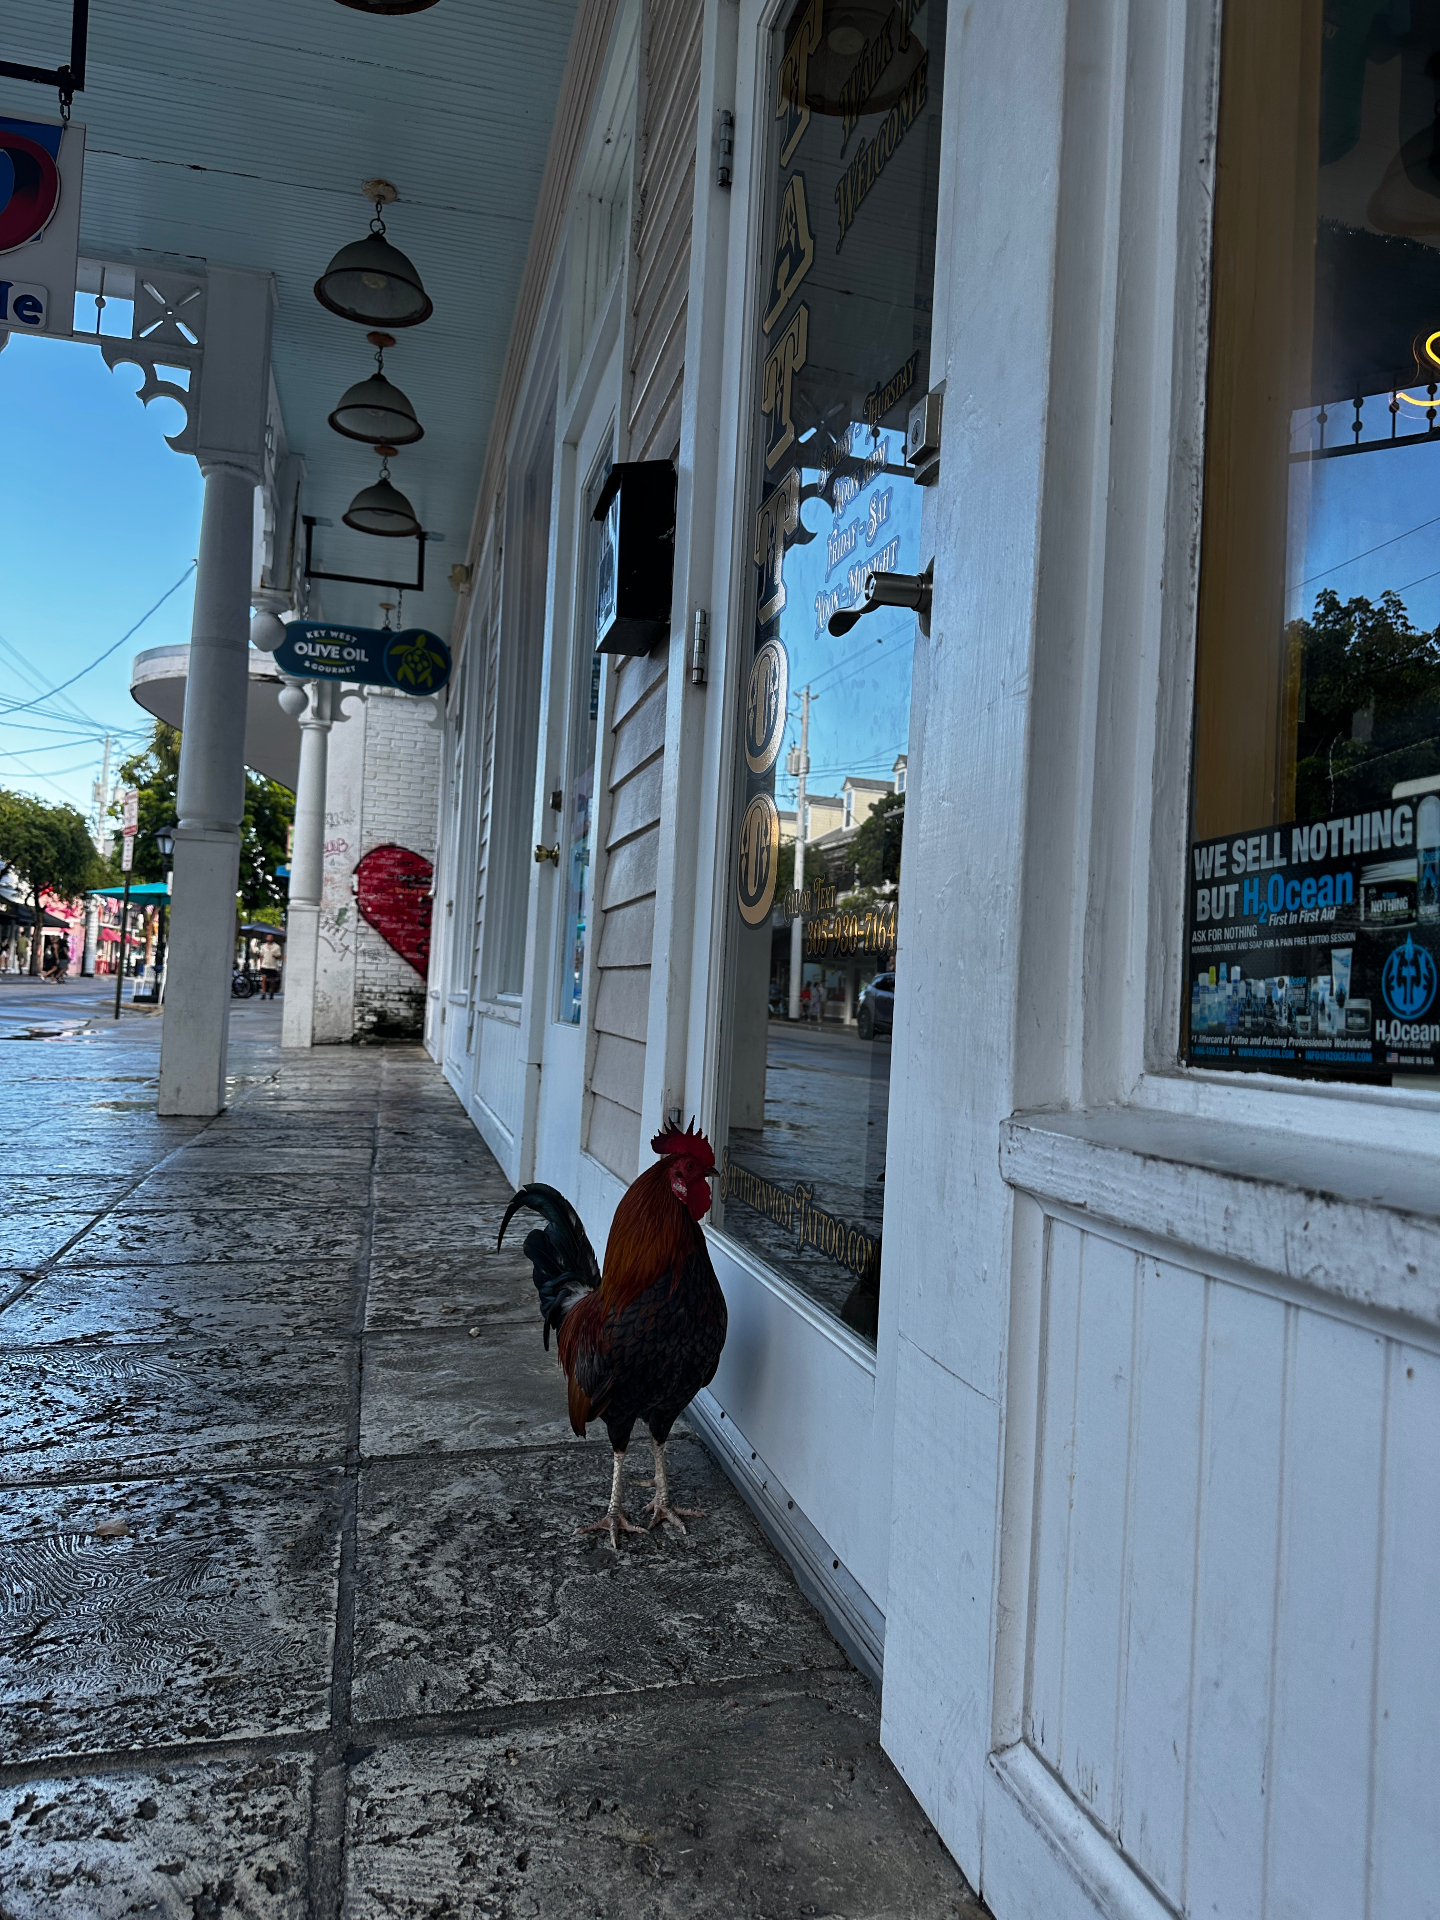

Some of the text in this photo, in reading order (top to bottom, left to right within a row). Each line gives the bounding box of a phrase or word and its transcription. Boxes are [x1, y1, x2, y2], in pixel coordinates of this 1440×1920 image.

[839, 8, 895, 158] WALK
[835, 50, 928, 254] WELCOME
[863, 350, 919, 445] THURSDAY
[825, 517, 859, 582] FRIDAY
[865, 487, 893, 546] SAT
[305, 630, 358, 643] KEY WEST
[294, 641, 369, 662] OLIVE OIL
[311, 662, 356, 674] GOURMET
[1194, 804, 1413, 880] WE SELL NOTHING
[800, 890, 811, 912] OR
[814, 872, 836, 915] TEXT
[1197, 871, 1353, 924] BUT H2Ocean
[1371, 897, 1408, 913] NOTHING
[1269, 907, 1336, 926] First In First Aid
[806, 908, 896, 955] 305-930-7164
[1192, 925, 1258, 943] ASK FOR NOTHING
[1213, 943, 1236, 953] OINTMENT
[1238, 941, 1248, 950] AND
[1249, 940, 1262, 950] SOAP
[1264, 939, 1272, 948] FOR
[1280, 937, 1293, 947] PAIN
[1294, 936, 1307, 946] FREE
[1308, 934, 1329, 944] TATTOO
[1330, 932, 1356, 943] SESSION
[1224, 1036, 1230, 1044] of
[1231, 1036, 1248, 1045] Tattoo
[1250, 1036, 1260, 1045] and
[1262, 1037, 1287, 1048] Piercing
[1288, 1037, 1332, 1048] Professionals
[1334, 1038, 1372, 1049] Worldwide
[1375, 1019, 1440, 1046] H2Ocean
[1400, 1055, 1415, 1064] MADE
[1423, 1056, 1434, 1065] USA
